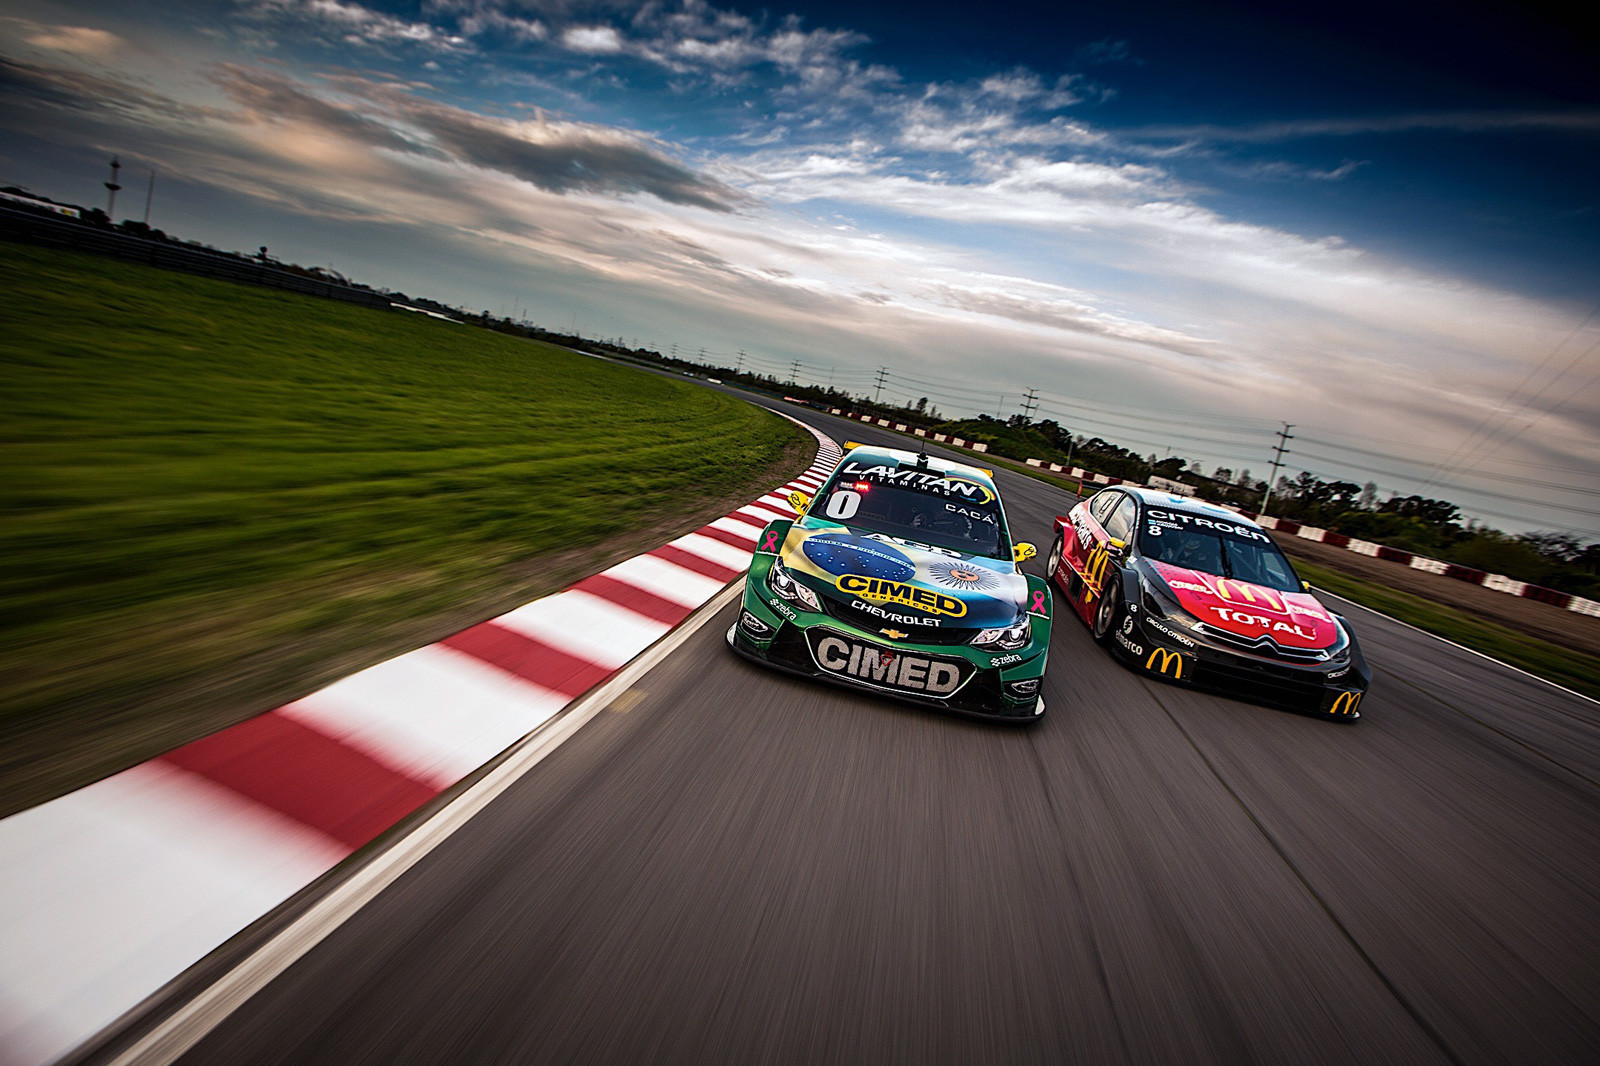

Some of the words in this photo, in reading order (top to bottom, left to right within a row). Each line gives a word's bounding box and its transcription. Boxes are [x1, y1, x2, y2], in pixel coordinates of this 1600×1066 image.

[843, 462, 977, 496] LAVITAN
[859, 475, 950, 496] VITAMINAS
[826, 490, 861, 519] 0
[1148, 525, 1162, 536] 8
[839, 575, 963, 615] CIMED
[1130, 603, 1138, 613] 8
[851, 600, 941, 627] CHEVROLET
[1210, 606, 1317, 641] TOTAL
[817, 636, 960, 693] CIMED
[999, 653, 1022, 665] zebra
